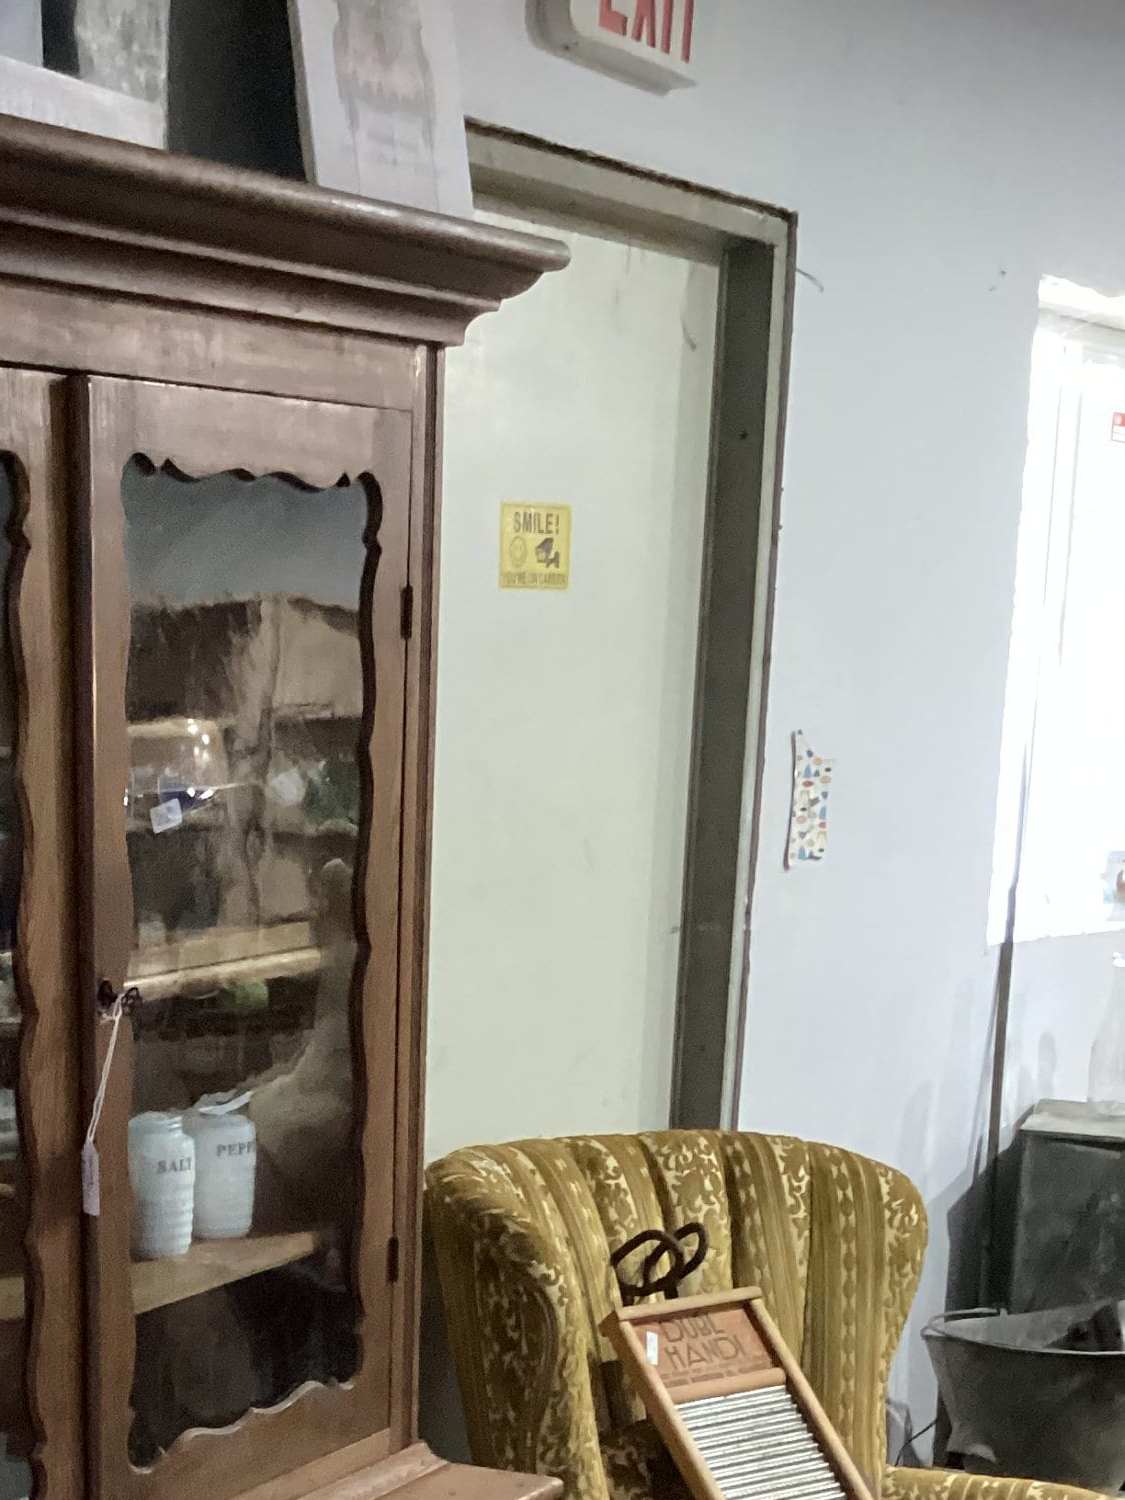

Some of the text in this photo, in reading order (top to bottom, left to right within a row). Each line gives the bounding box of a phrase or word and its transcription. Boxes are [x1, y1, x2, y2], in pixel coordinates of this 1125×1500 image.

[512, 511, 560, 535] SMILE!
[155, 1156, 193, 1175] SALT
[665, 1334, 748, 1371] HANDI
